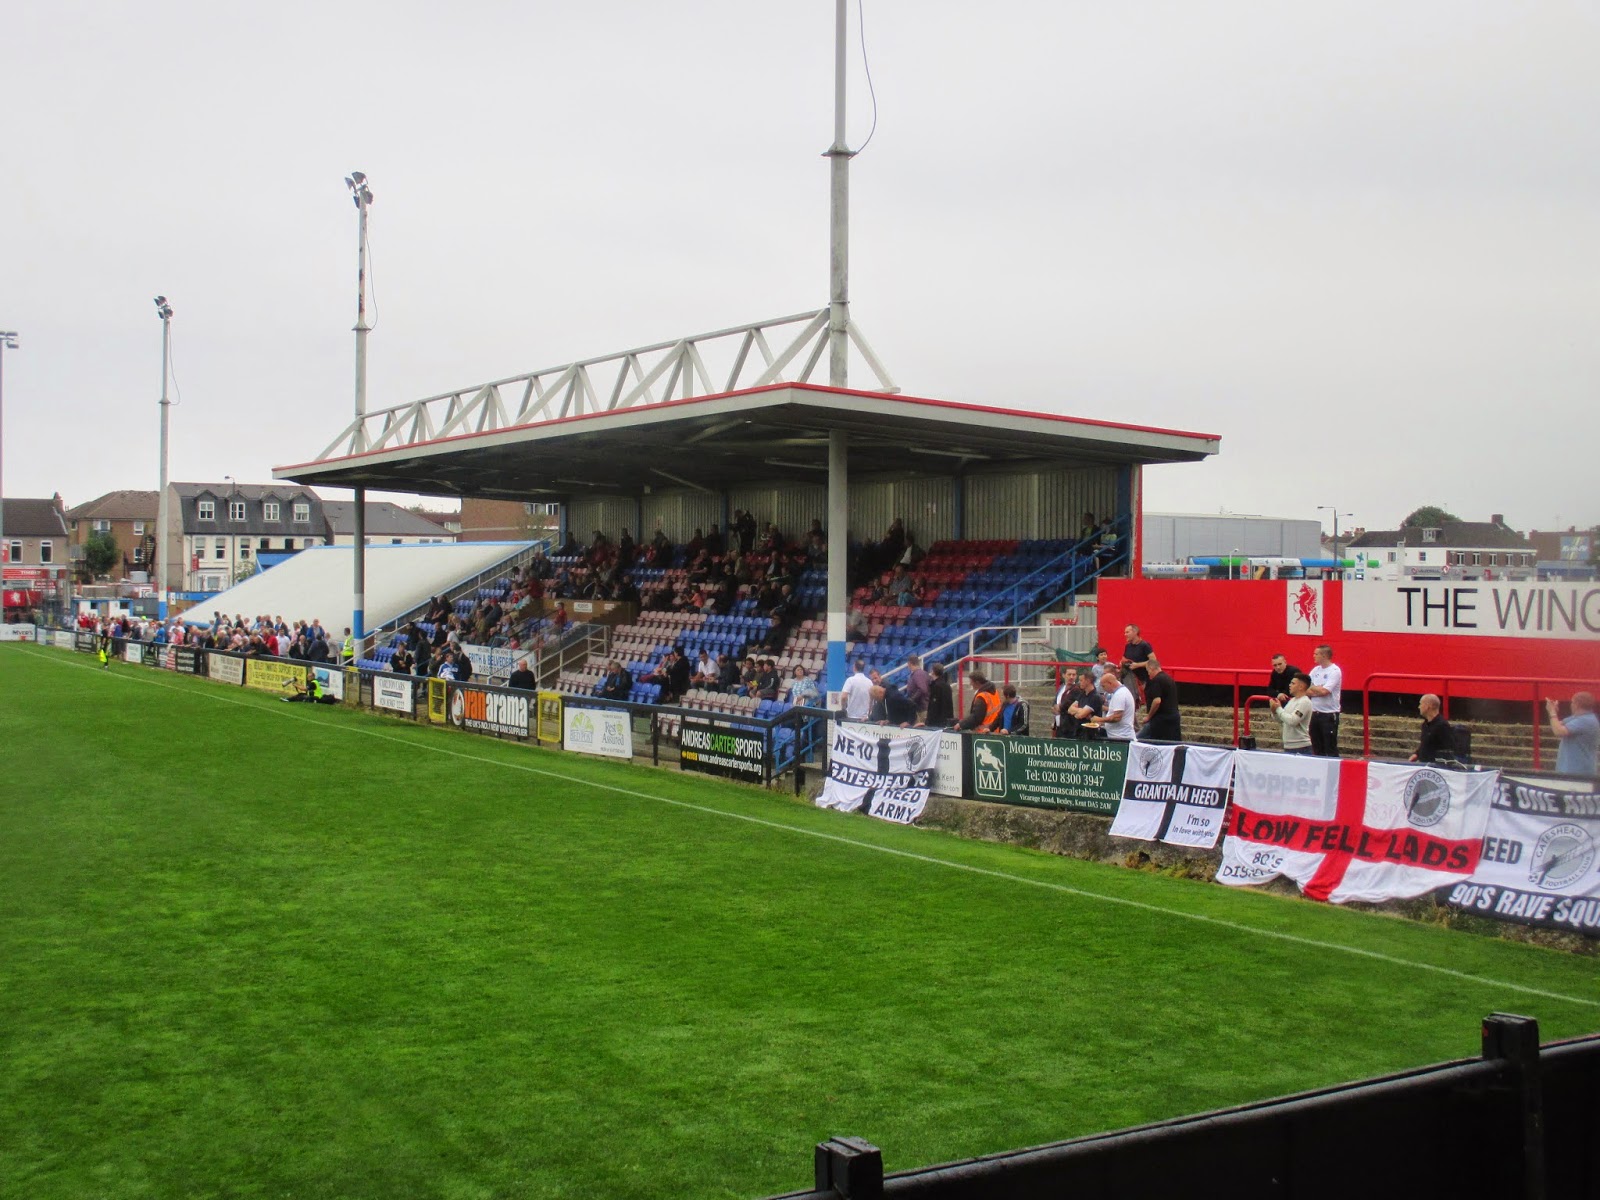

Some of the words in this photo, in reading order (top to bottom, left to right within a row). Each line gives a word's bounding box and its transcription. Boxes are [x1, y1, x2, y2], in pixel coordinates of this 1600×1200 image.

[1397, 587, 1478, 628] THE
[464, 689, 528, 728] vanarama
[508, 726, 528, 737] SUPPLIER
[1009, 741, 1041, 756] Mount
[1044, 743, 1079, 759] Mascal
[1083, 744, 1122, 762] Stables
[831, 762, 911, 790] GATESHEAD
[1027, 757, 1077, 771] Horsemanship
[1078, 761, 1090, 773] for
[1091, 762, 1102, 772] All
[1025, 769, 1040, 782] Tel:
[1042, 771, 1057, 783] 020
[1060, 772, 1081, 785] 8300
[1083, 774, 1104, 787] 3947
[1011, 782, 1120, 801] www.mountmascalstables.co.uk
[1134, 783, 1188, 803] GRANTHAM
[1190, 787, 1220, 807] HEED
[1515, 786, 1559, 813] ONE
[875, 802, 916, 821] ARMY
[1237, 811, 1299, 845] LOW
[1303, 825, 1374, 857] FELL
[1385, 833, 1470, 869] LADS
[1536, 827, 1583, 858] GATESHEAD
[1449, 884, 1496, 910] 90'S
[1495, 890, 1554, 920] RAVE
